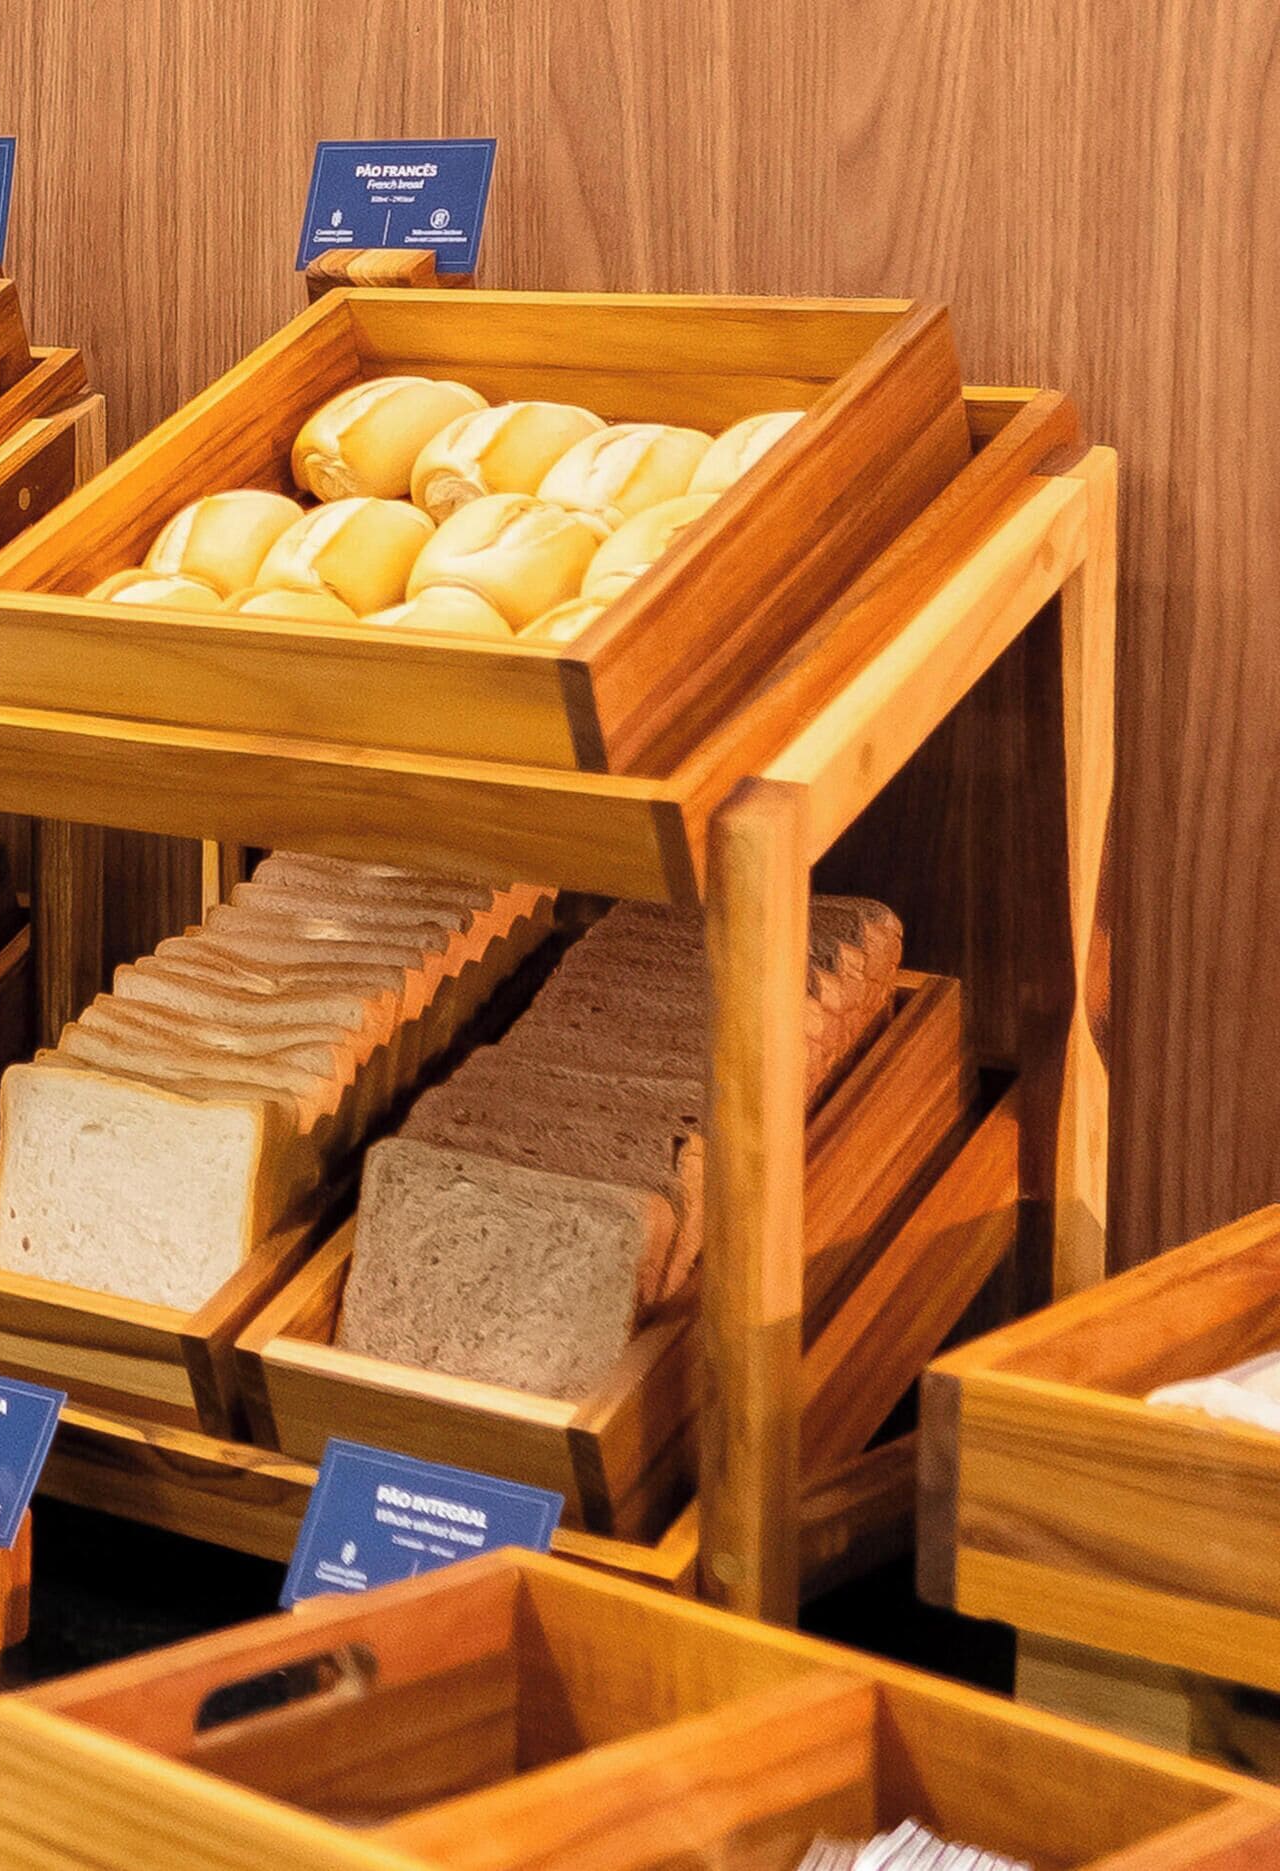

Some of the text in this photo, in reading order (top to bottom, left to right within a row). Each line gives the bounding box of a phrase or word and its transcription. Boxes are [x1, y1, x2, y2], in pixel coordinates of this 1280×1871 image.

[356, 163, 438, 177] PÃO FRANCÊS
[367, 179, 425, 190] French bread
[377, 1484, 488, 1529] PÃO INTEGRAL
